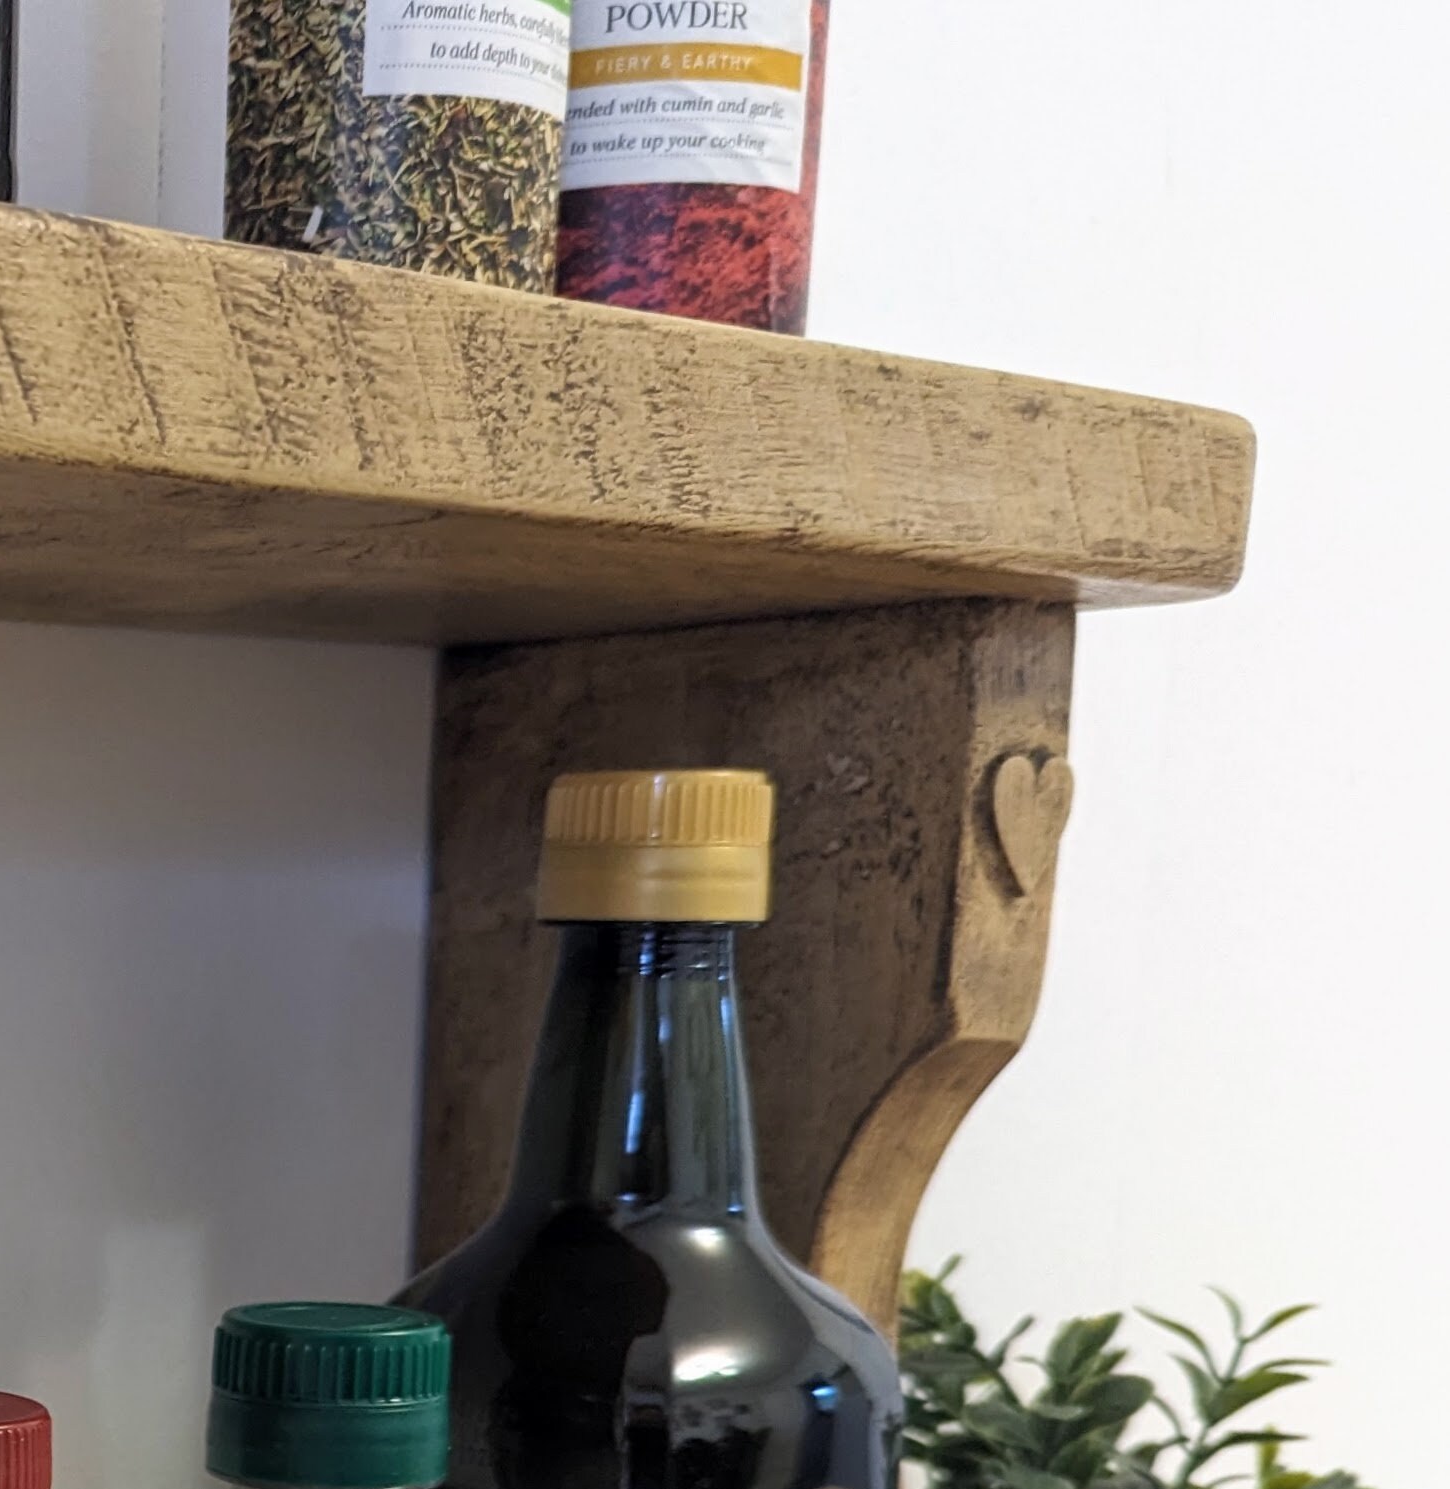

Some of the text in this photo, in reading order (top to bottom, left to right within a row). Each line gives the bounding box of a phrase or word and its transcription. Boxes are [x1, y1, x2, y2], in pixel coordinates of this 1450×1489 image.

[402, 1, 476, 21] Aromatic
[480, 4, 517, 28] herbs,
[606, 1, 748, 33] POWDER
[430, 42, 446, 59] to
[449, 42, 479, 60] add
[482, 43, 518, 67] depth
[519, 53, 530, 69] to
[595, 54, 753, 75] FIERY & EARTHY
[620, 97, 656, 115] with
[661, 96, 713, 113] cumin
[717, 98, 747, 114] and
[750, 101, 784, 121] garlic
[570, 134, 765, 156] to wake up your cooking
